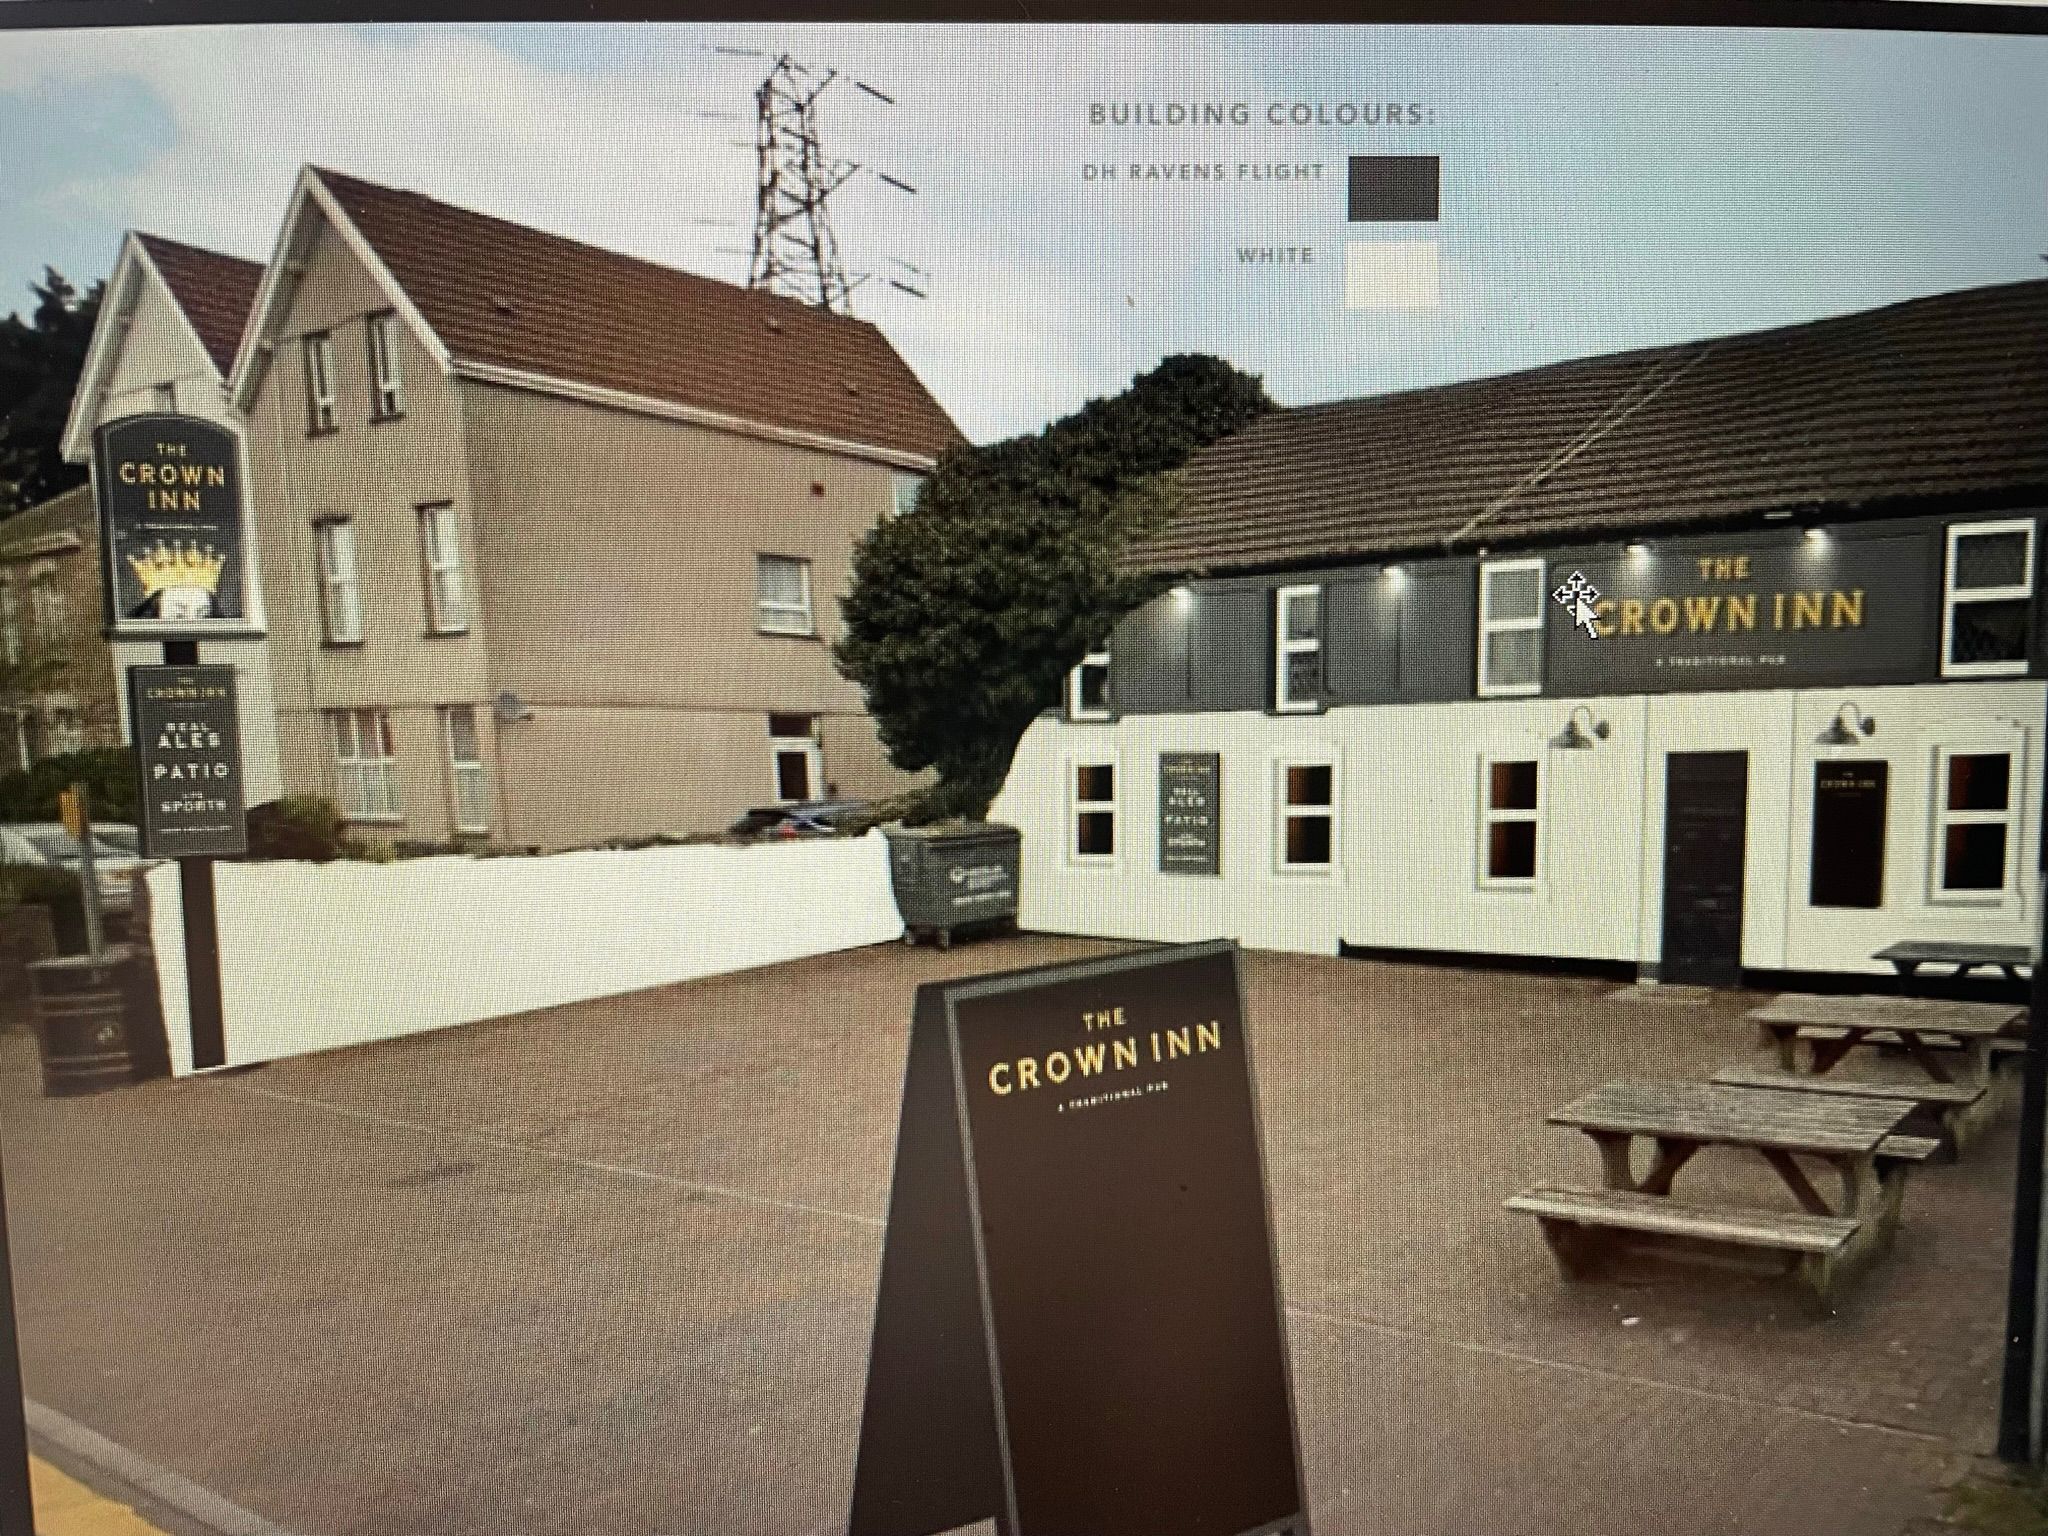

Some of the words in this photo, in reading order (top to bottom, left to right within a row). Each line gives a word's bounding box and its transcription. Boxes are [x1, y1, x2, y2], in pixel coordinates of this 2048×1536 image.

[1089, 103, 1250, 125] BUILDING
[1267, 103, 1436, 126] COLOURS:
[1082, 163, 1116, 181] DH
[1129, 163, 1224, 181] RAVENS
[1238, 163, 1325, 180] FLIGHT
[1237, 246, 1314, 263] WHITE
[156, 442, 188, 456] THE
[119, 461, 225, 488] CROWN
[148, 489, 200, 511] INN
[1697, 556, 1750, 580] THE
[1594, 594, 1757, 637] CROWN
[1772, 589, 1865, 631] INN
[158, 733, 221, 749] ALES
[153, 763, 230, 779] PATIO
[1082, 1006, 1127, 1032] THE
[988, 1036, 1138, 1096] CROWN
[1150, 1020, 1222, 1063] INN
